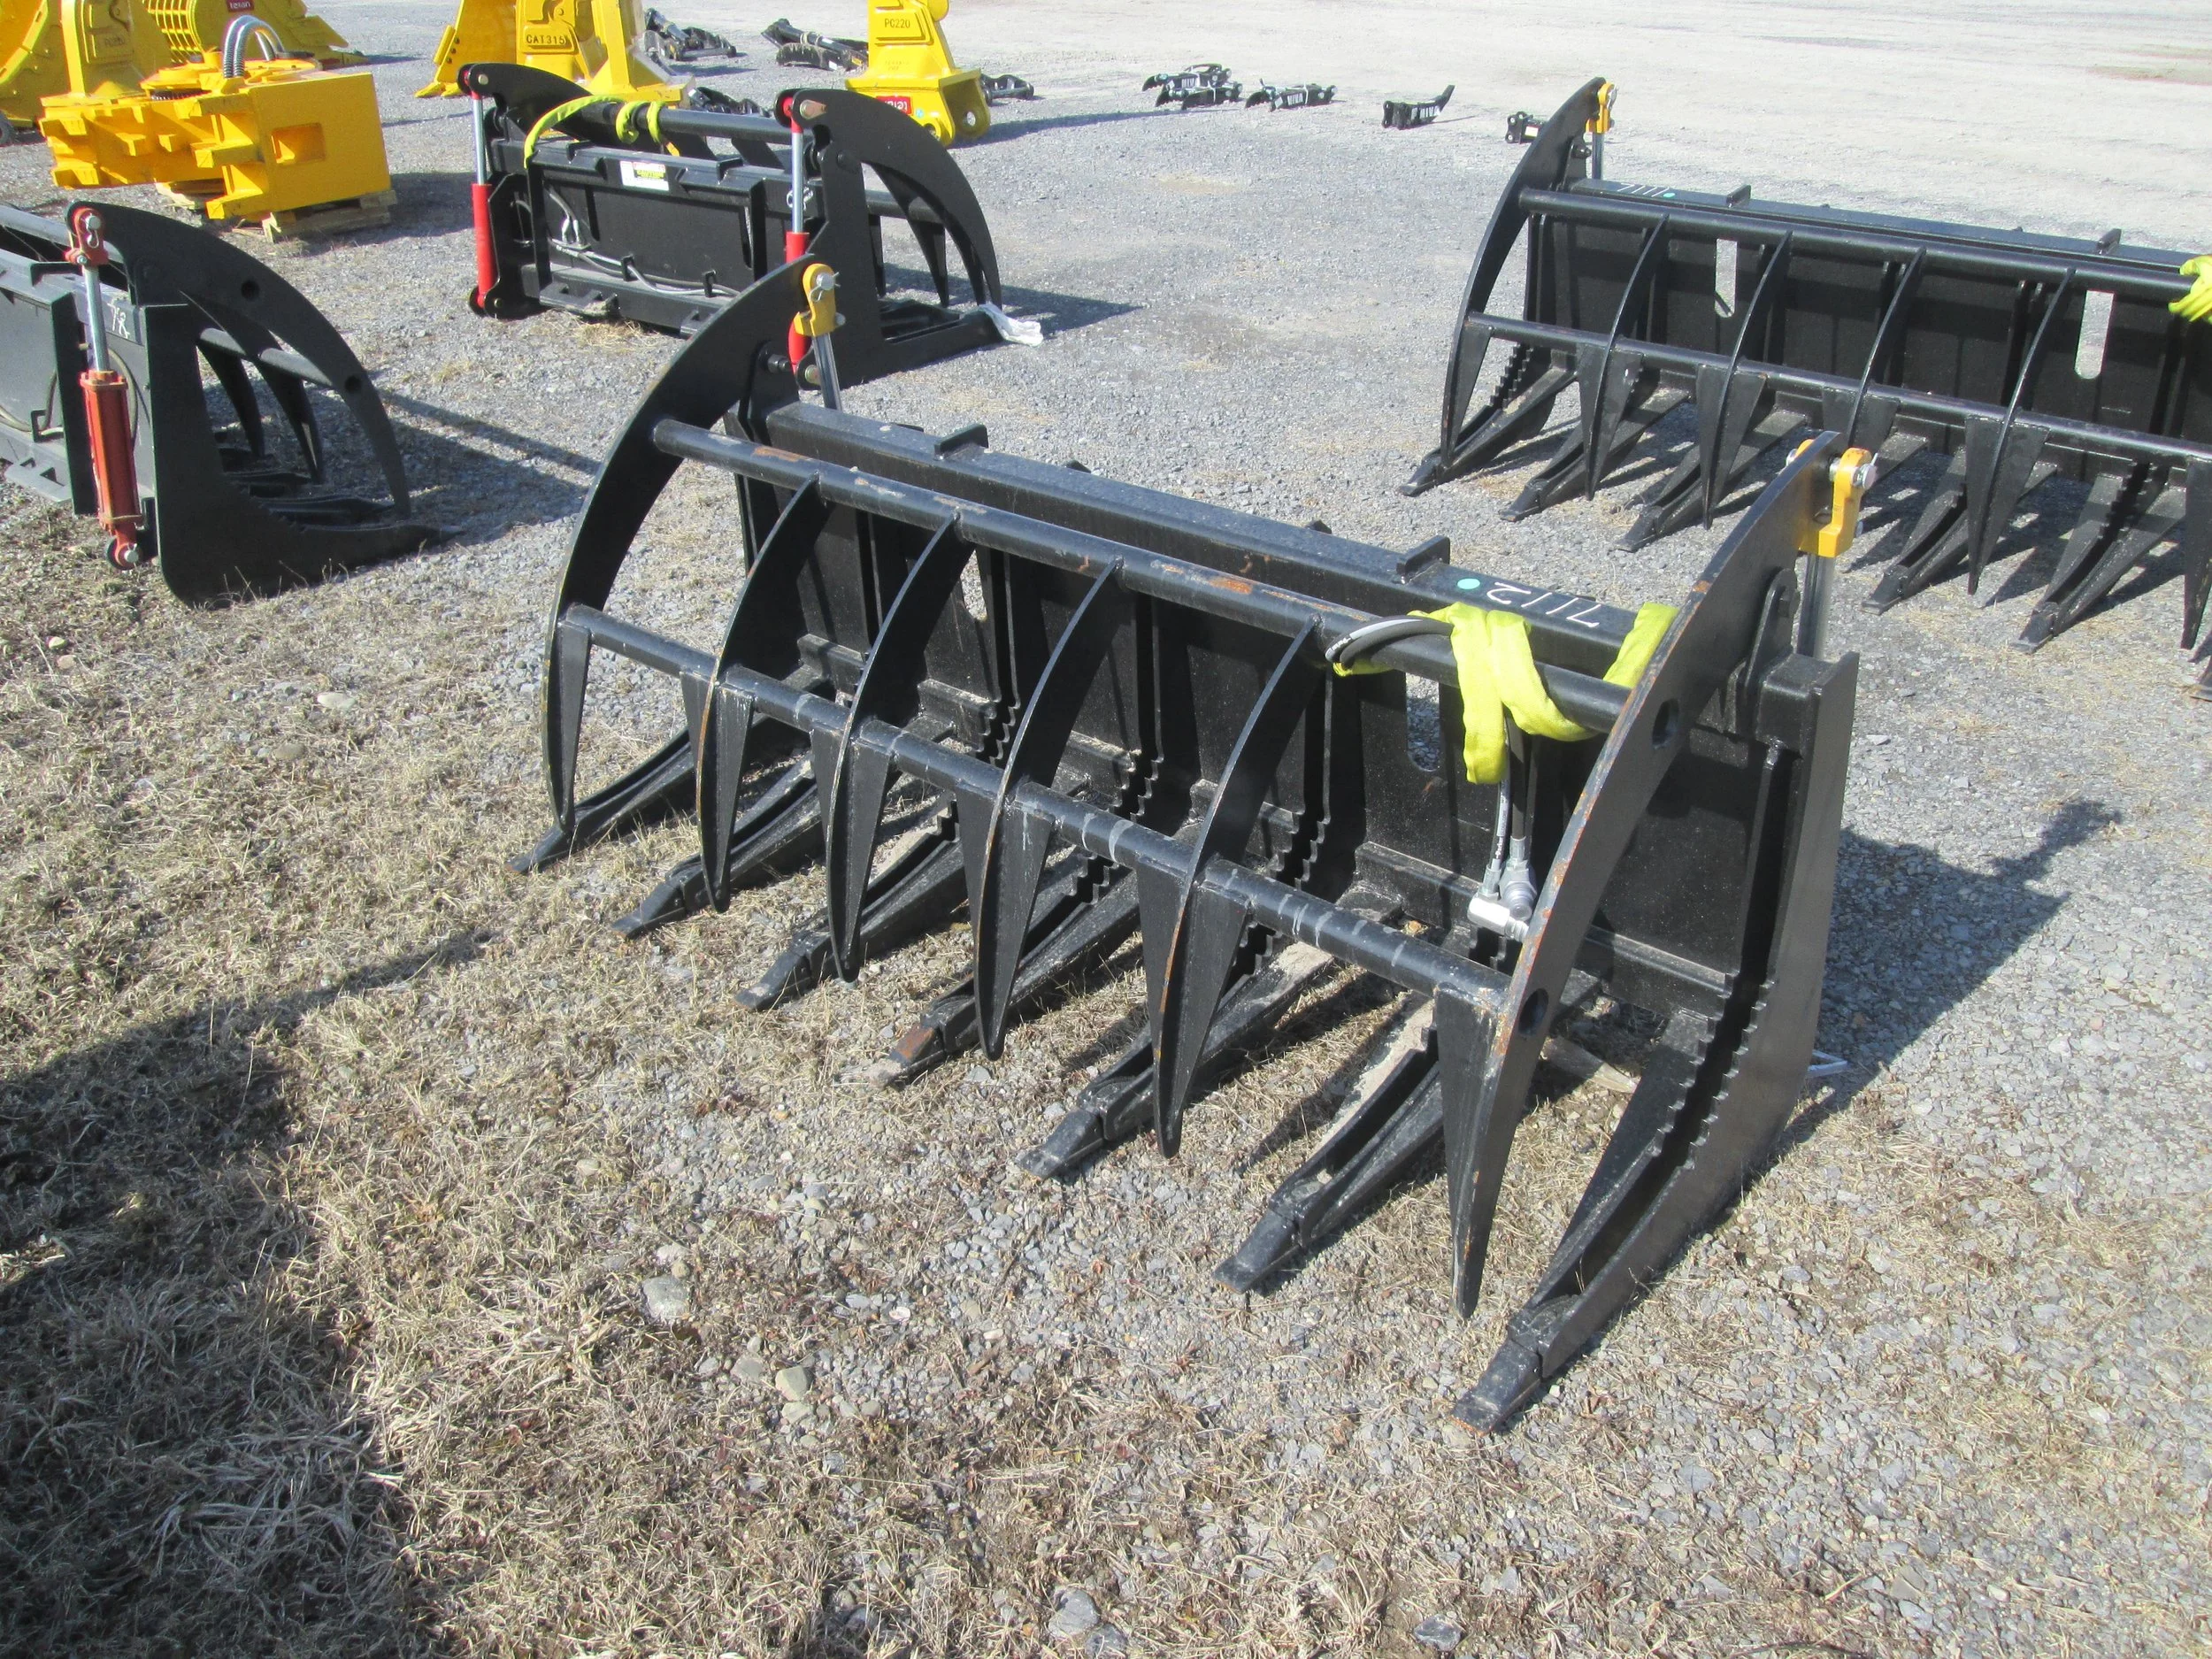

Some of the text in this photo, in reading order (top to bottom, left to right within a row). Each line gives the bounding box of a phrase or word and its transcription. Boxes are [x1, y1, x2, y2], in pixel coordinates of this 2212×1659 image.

[884, 18, 910, 28] PC220
[526, 35, 565, 45] CAT315
[1486, 581, 1601, 628] 7112
